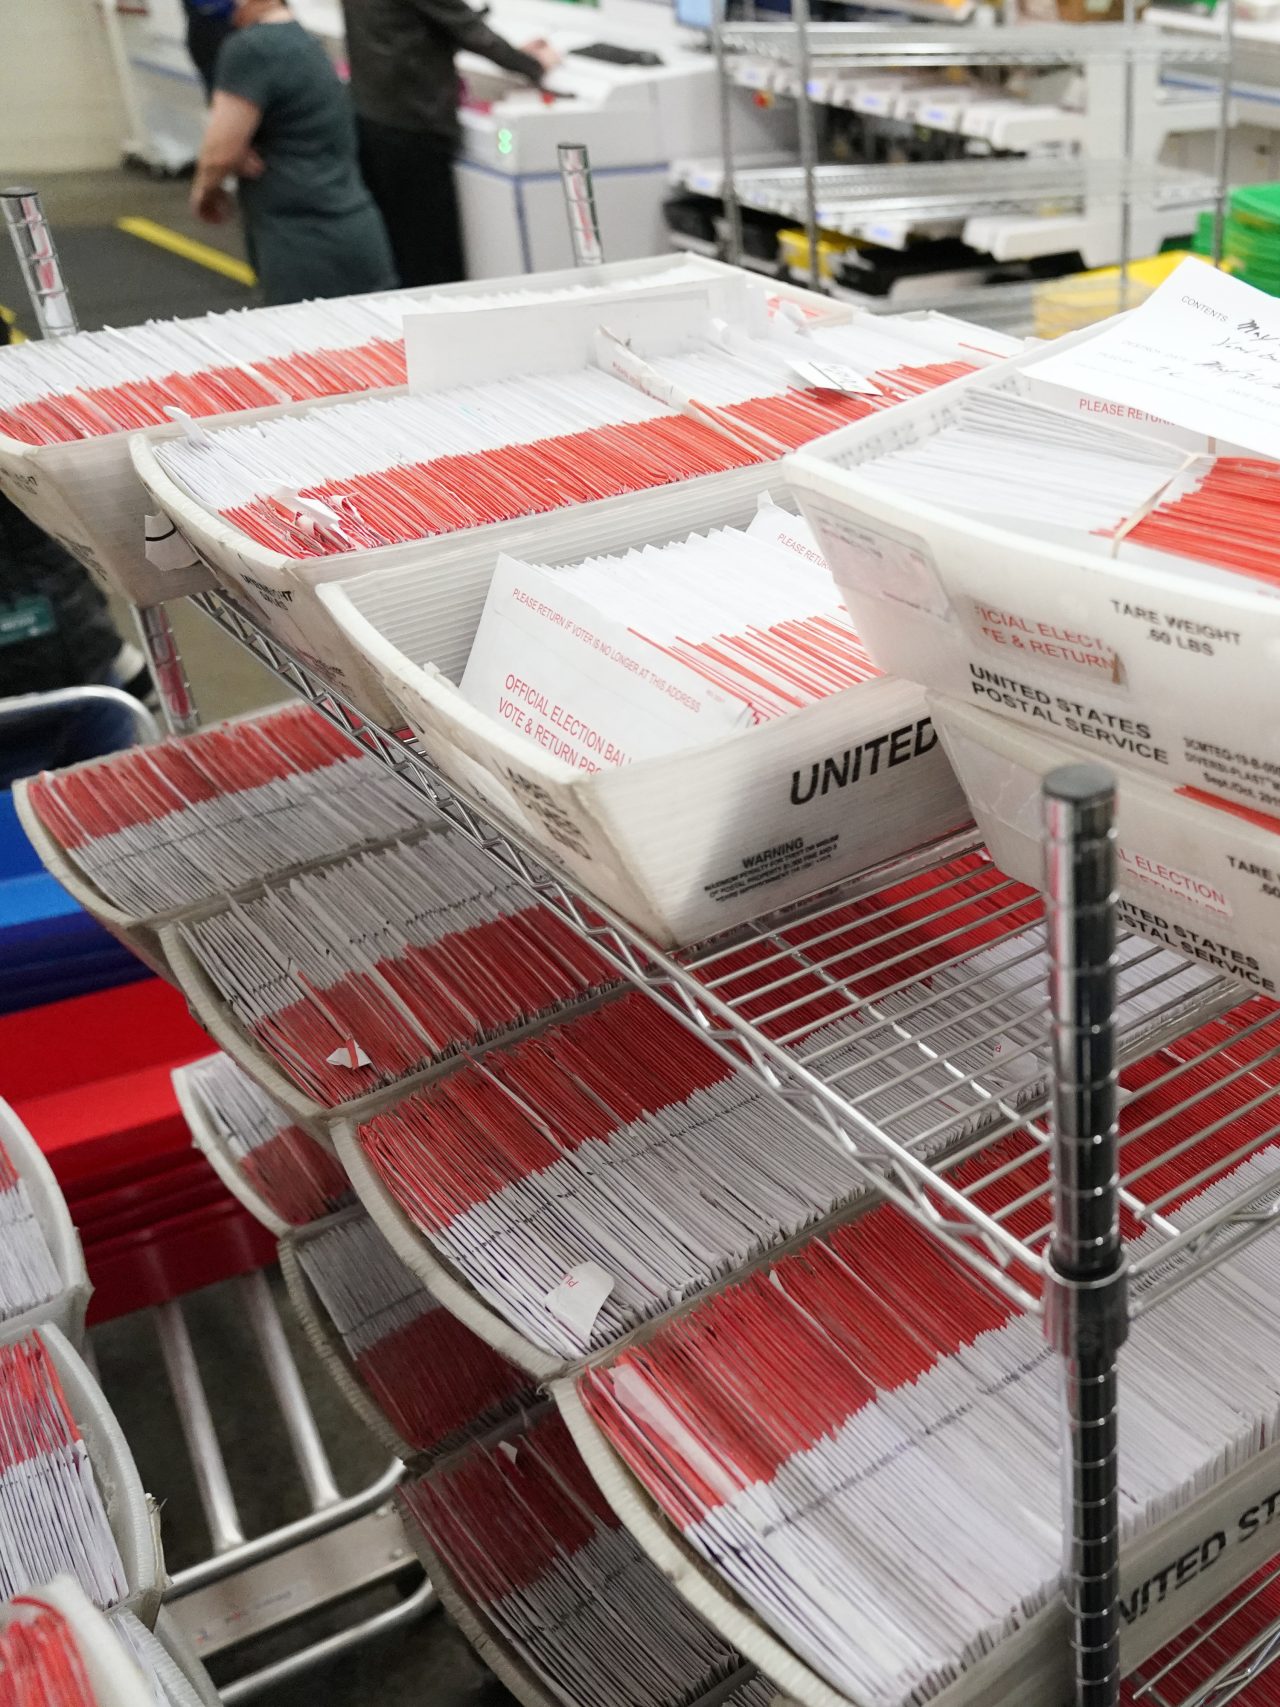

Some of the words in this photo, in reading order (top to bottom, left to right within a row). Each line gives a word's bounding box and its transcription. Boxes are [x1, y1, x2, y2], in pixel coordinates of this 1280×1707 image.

[1181, 295, 1229, 323] CONTENTS
[1079, 398, 1125, 417] PLEASE
[777, 533, 807, 556] PLEASE
[1011, 634, 1025, 649] &
[1110, 599, 1161, 625] TARE
[1164, 615, 1241, 645] WEIGHT
[1176, 636, 1214, 656] LBS
[512, 587, 538, 611] PLEASE
[537, 603, 565, 626] RETURN
[564, 620, 573, 631] IF
[572, 624, 594, 646] VOTER
[593, 636, 600, 649] IS
[599, 642, 611, 656] NO
[610, 651, 640, 674] LONGER
[638, 668, 650, 680] AT
[649, 672, 666, 691] THIS
[665, 683, 701, 714] ADDRESS
[505, 674, 549, 717] OFFICIAL
[549, 705, 605, 755] ELECTION
[969, 663, 1051, 705] UNITED
[1056, 698, 1151, 740] STATES
[971, 681, 1061, 726] POSTAL
[1065, 717, 1169, 765] SERVICE
[498, 696, 526, 728] VOTE
[524, 718, 533, 735] &
[534, 724, 578, 767] RETURN
[790, 716, 939, 806] UNITED
[742, 836, 804, 869] WARNING
[1226, 854, 1273, 882] TARE
[1135, 855, 1226, 906] ELECTION
[1117, 899, 1169, 930] ITED
[1173, 924, 1260, 971] STATES
[1181, 941, 1276, 993] SERVICE
